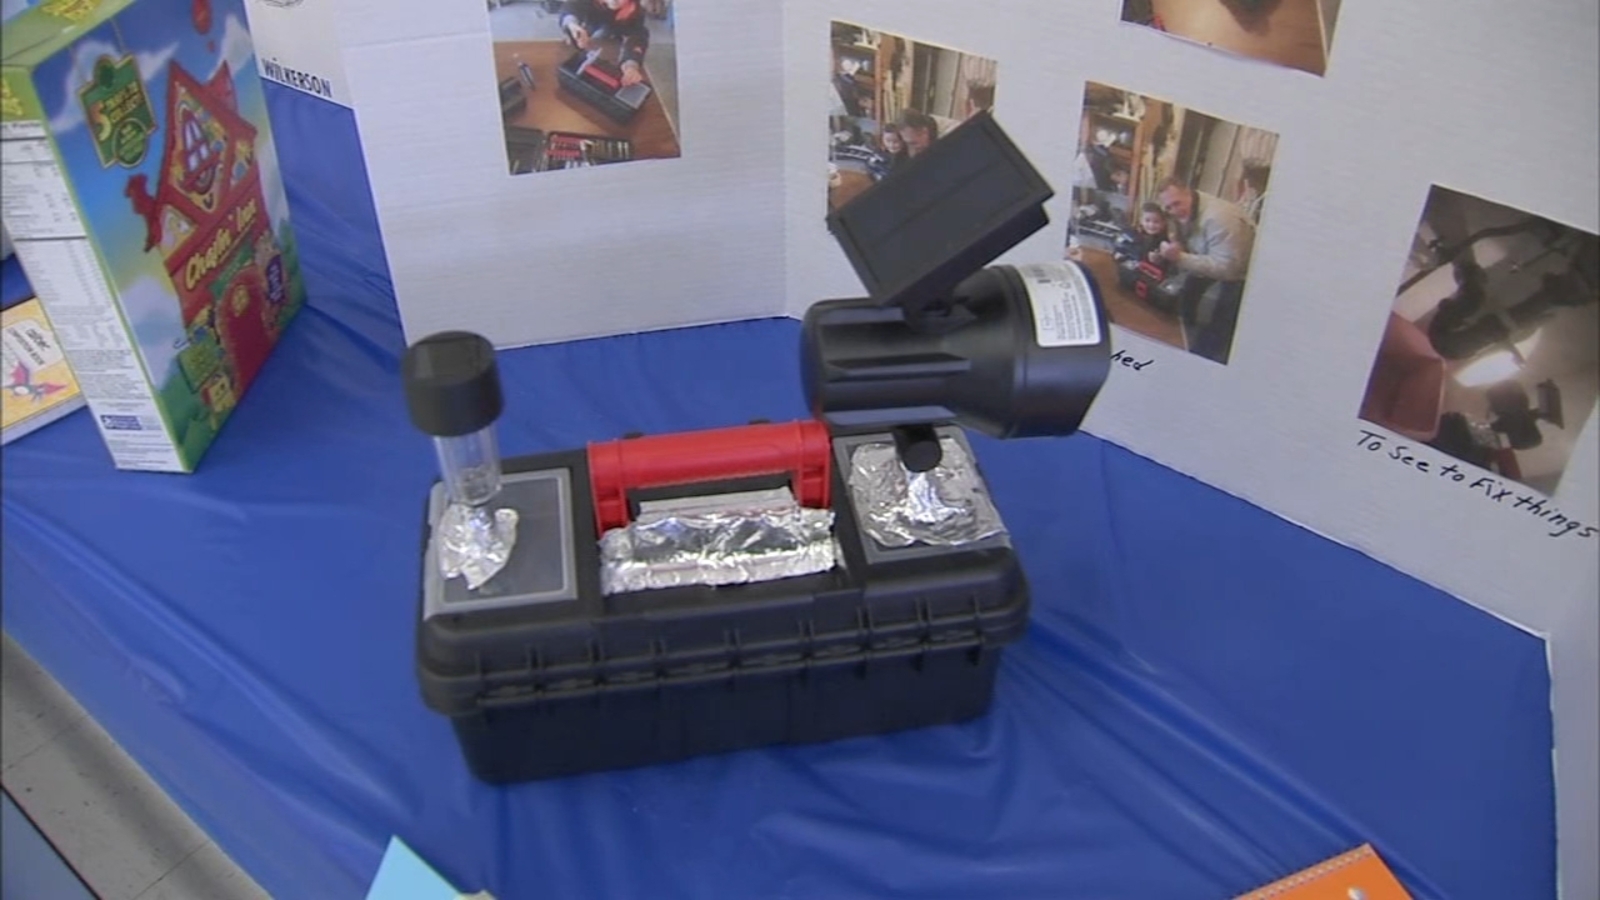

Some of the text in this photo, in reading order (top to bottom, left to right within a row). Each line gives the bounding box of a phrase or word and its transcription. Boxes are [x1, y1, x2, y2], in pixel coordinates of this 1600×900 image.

[1357, 430, 1599, 538] To See to Fix things
